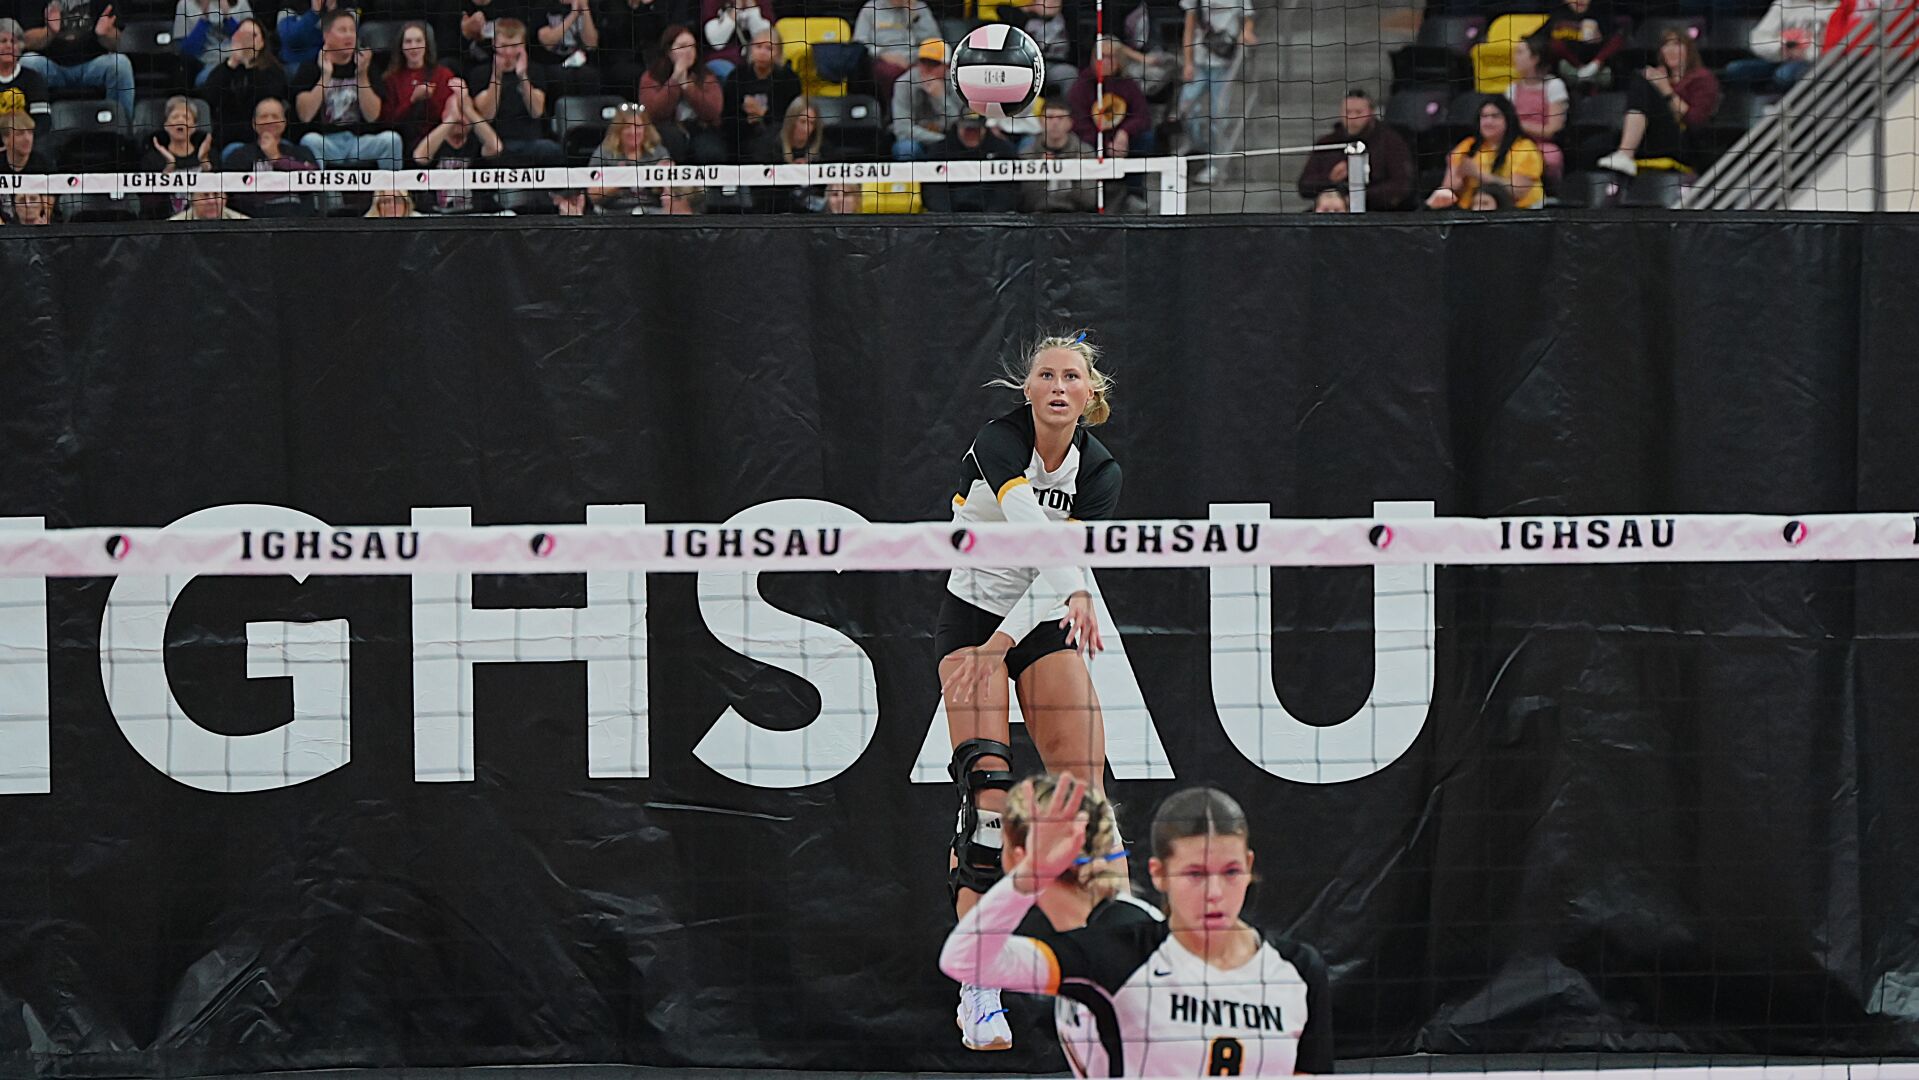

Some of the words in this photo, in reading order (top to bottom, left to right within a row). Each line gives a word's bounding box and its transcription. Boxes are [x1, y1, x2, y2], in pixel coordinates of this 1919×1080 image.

[645, 168, 719, 181] IGHSAU
[818, 166, 891, 178] IGHSAU
[990, 163, 1063, 175] IGHSAU
[123, 173, 197, 187] IGHSAU
[298, 172, 372, 185] IGHSAU
[471, 171, 545, 184] IGHSAU
[1084, 524, 1260, 554] IGHSAU
[1500, 519, 1675, 550] IGHSAU
[241, 531, 419, 560] IGHSAU
[664, 528, 842, 558] IGHSAU
[1171, 993, 1284, 1032] HINTON
